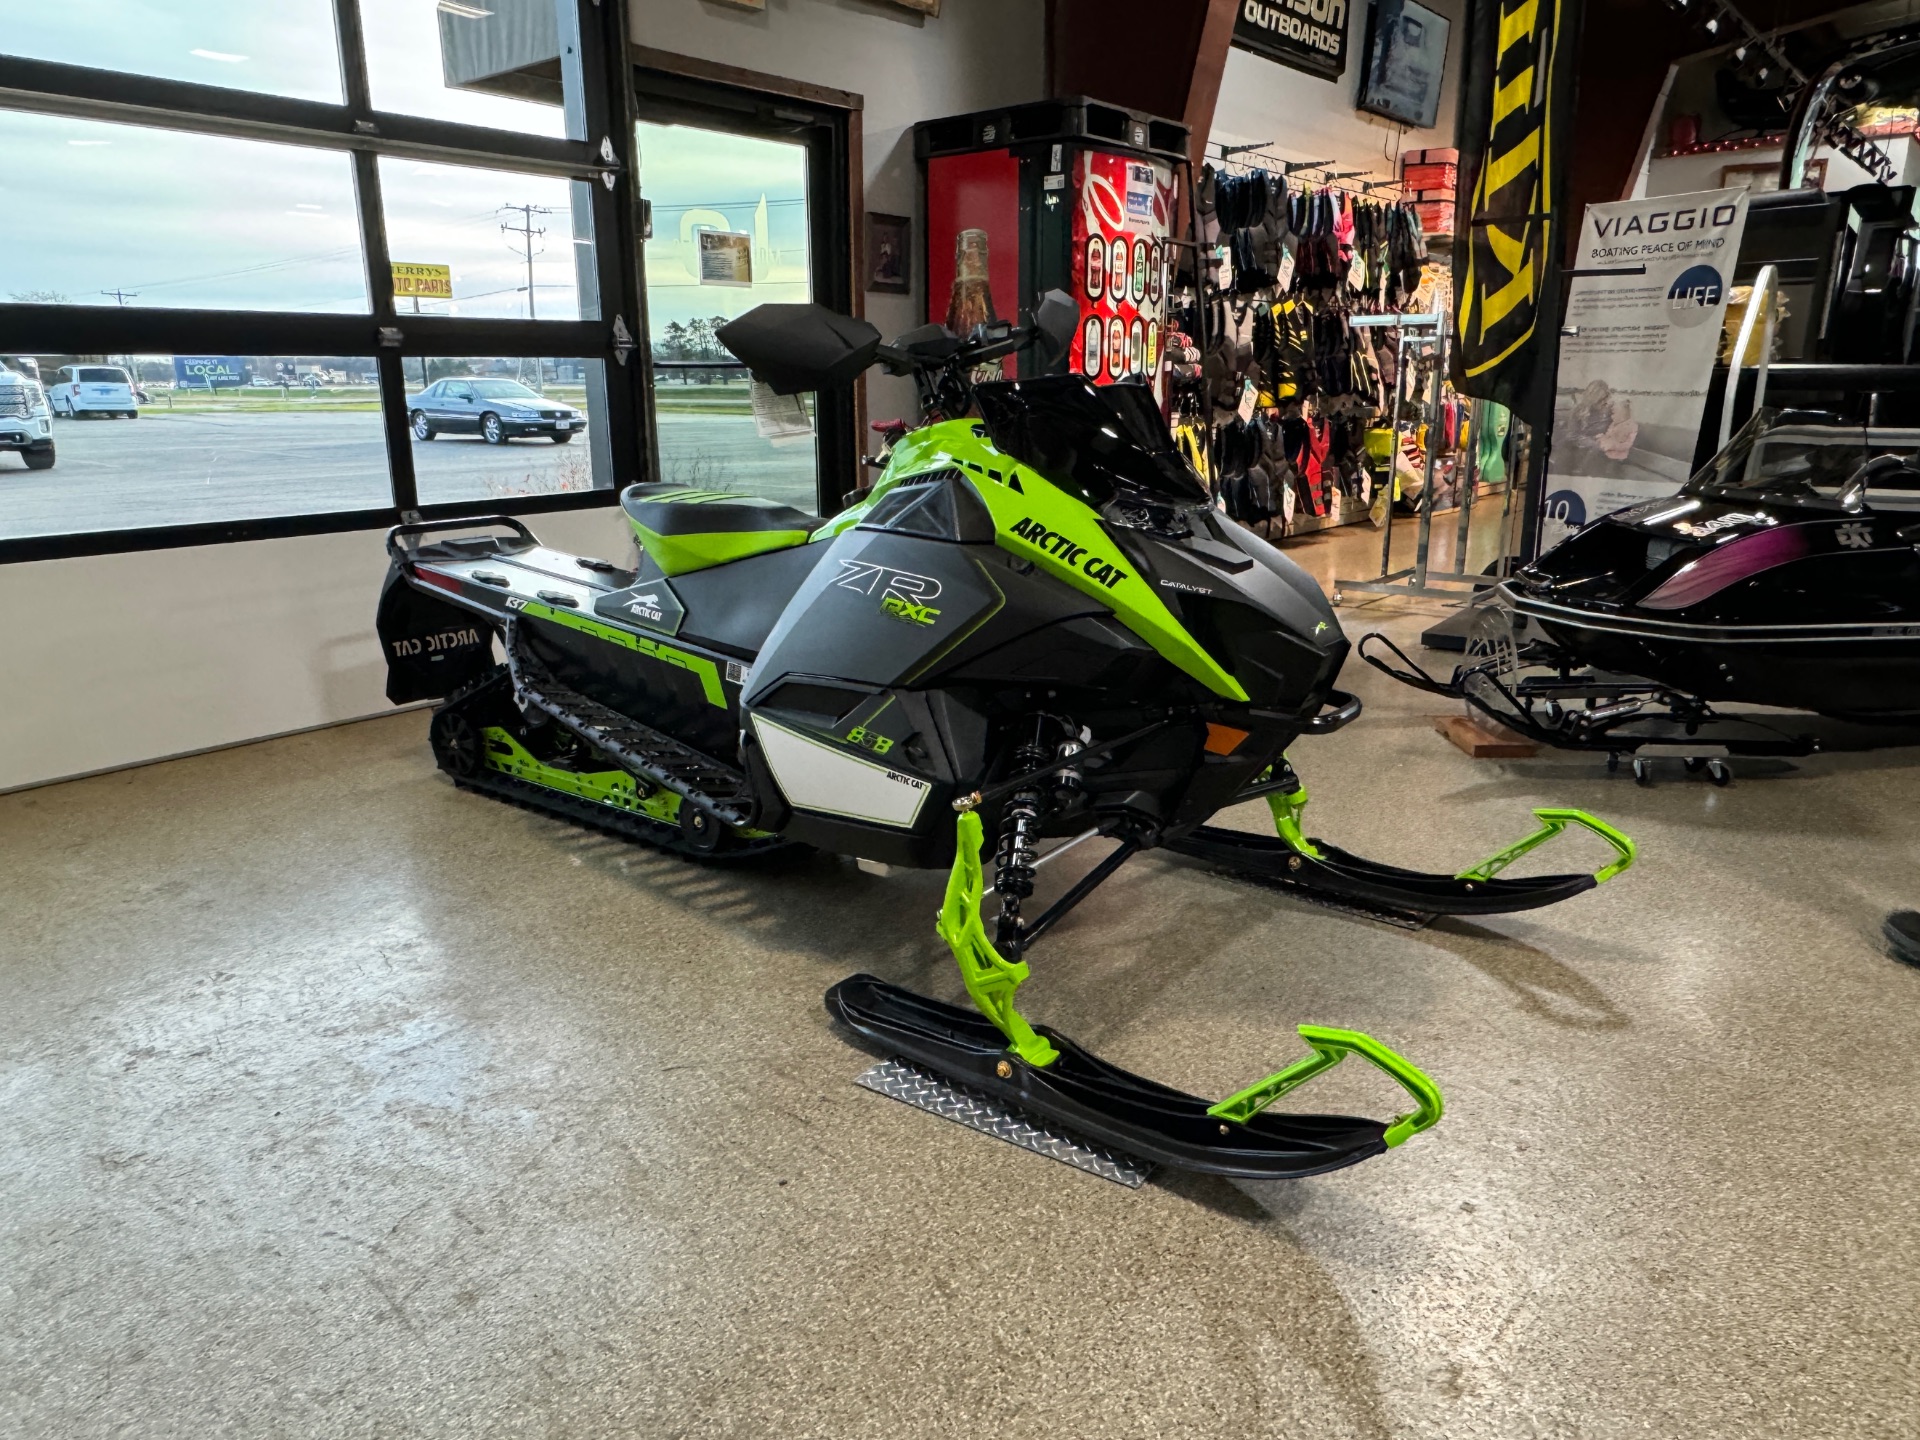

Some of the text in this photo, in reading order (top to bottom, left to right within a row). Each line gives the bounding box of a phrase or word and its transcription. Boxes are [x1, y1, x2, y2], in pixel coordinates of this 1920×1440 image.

[1244, 0, 1341, 56] OUTBOARDS
[1594, 204, 1737, 239] VIAGGIO
[1591, 244, 1638, 259] BOATING
[1641, 242, 1674, 254] PEACE
[1677, 240, 1693, 251] OF
[1695, 237, 1725, 250] MIND
[415, 278, 452, 294] PARTS
[1671, 285, 1719, 310] LIFE
[185, 365, 238, 376] LOCAL
[1544, 500, 1570, 523] 10
[1009, 517, 1128, 589] ARCTIC CAT
[1160, 579, 1213, 595] CATALYST
[630, 603, 663, 622] ARCTIC CAT
[886, 771, 924, 790] ARCTIC CAT
